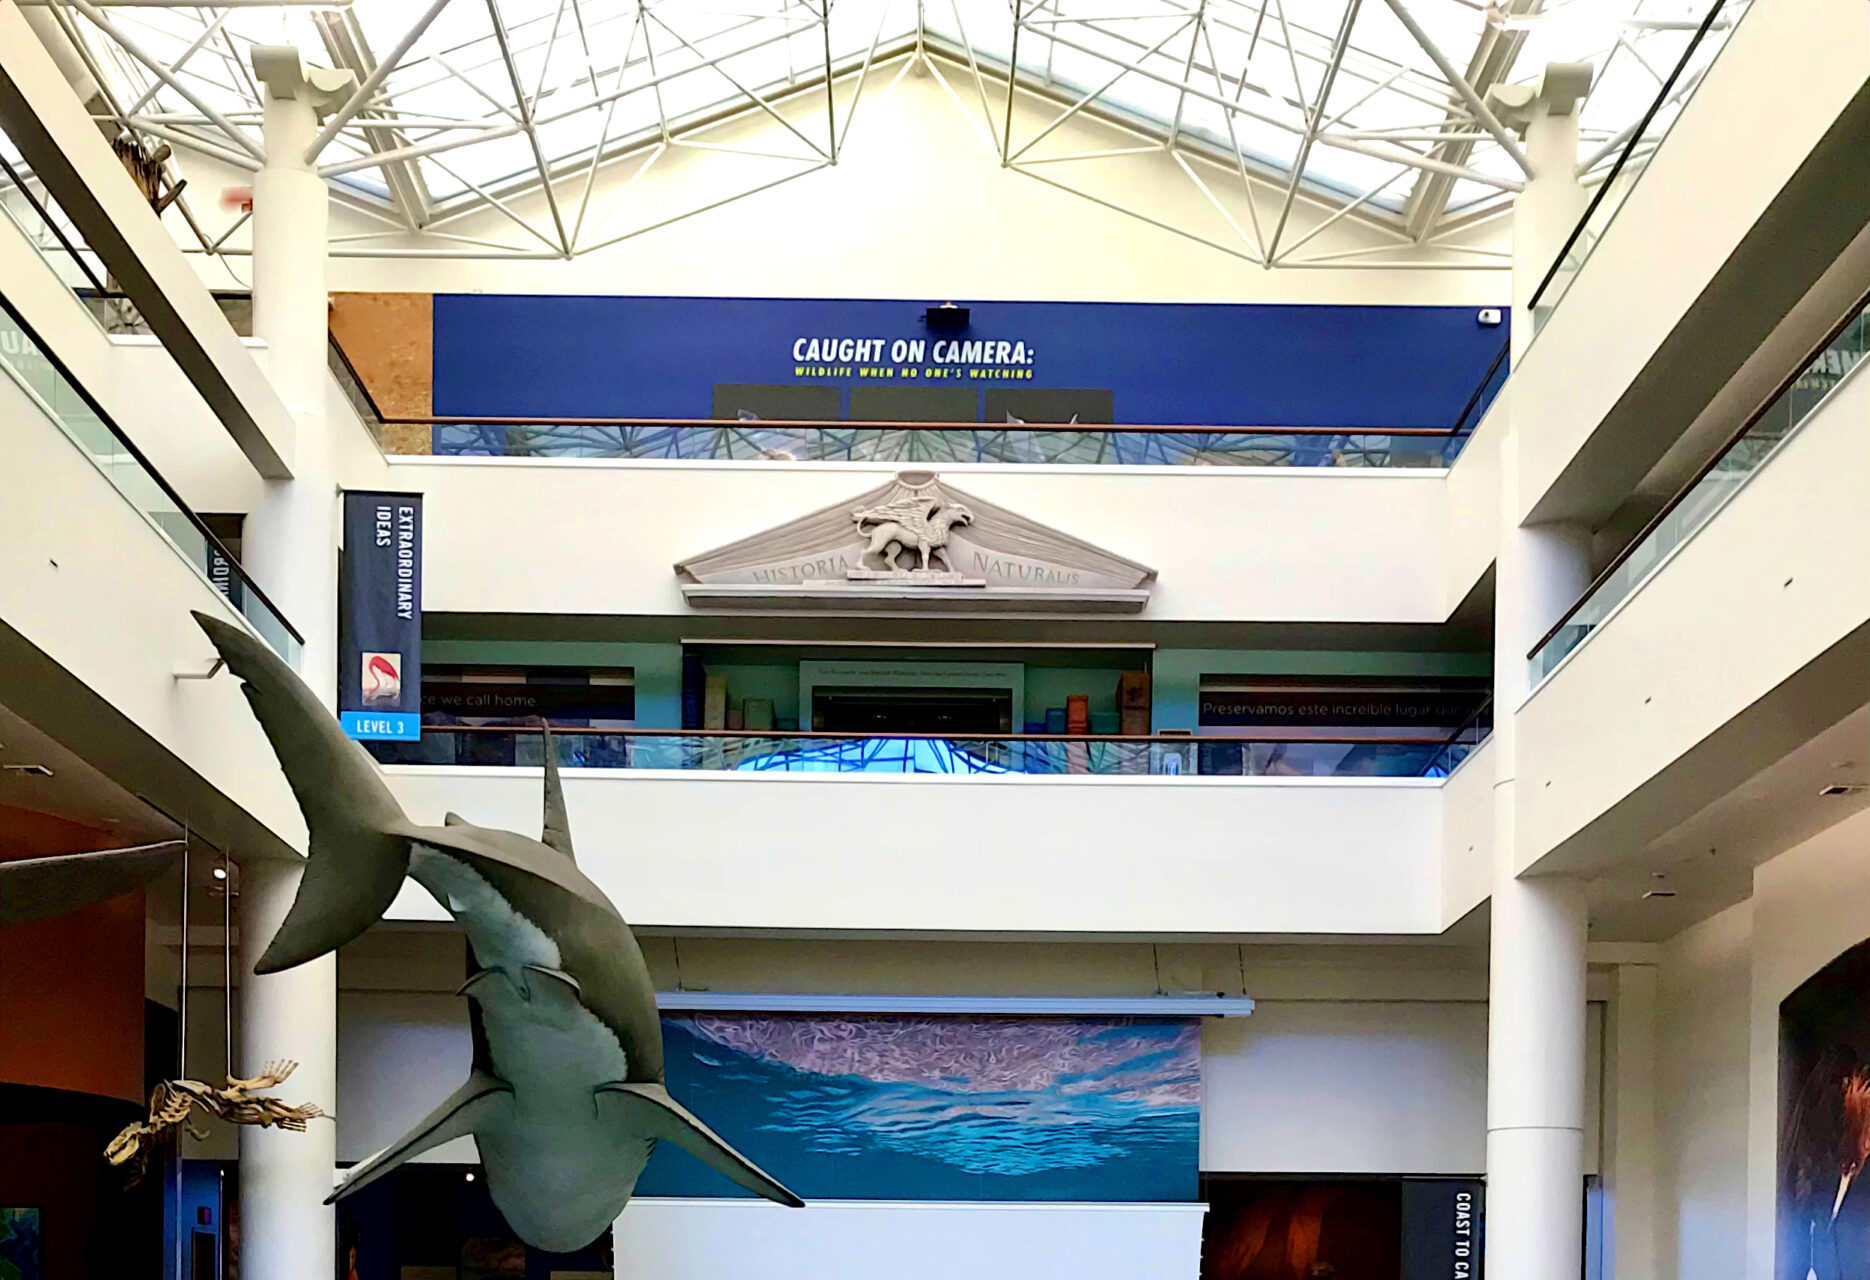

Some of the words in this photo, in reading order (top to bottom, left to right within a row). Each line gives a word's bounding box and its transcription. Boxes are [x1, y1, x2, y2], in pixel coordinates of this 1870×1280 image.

[793, 338, 885, 363] CAUGHT
[891, 340, 924, 364] ON
[932, 340, 1034, 365] CAMERA:
[795, 367, 852, 377] WILDLIFE
[859, 367, 893, 378] WHEN
[901, 368, 917, 378] NO
[925, 368, 962, 379] ONE'S
[970, 369, 1033, 380] WATCHING
[376, 506, 392, 547] IDEAS
[398, 506, 413, 620] EXTRAORDINARY
[752, 556, 850, 584] HISTORIA
[973, 551, 1080, 585] NATURALIS
[441, 695, 462, 706] we
[466, 693, 490, 706] call
[1203, 702, 1294, 716] Preservamos
[1299, 704, 1328, 716] este
[1396, 702, 1431, 718] lugar
[356, 720, 392, 734] LEVEL
[397, 721, 404, 734] 3
[1455, 1193, 1471, 1237] COAST
[1455, 1240, 1470, 1256] TO
